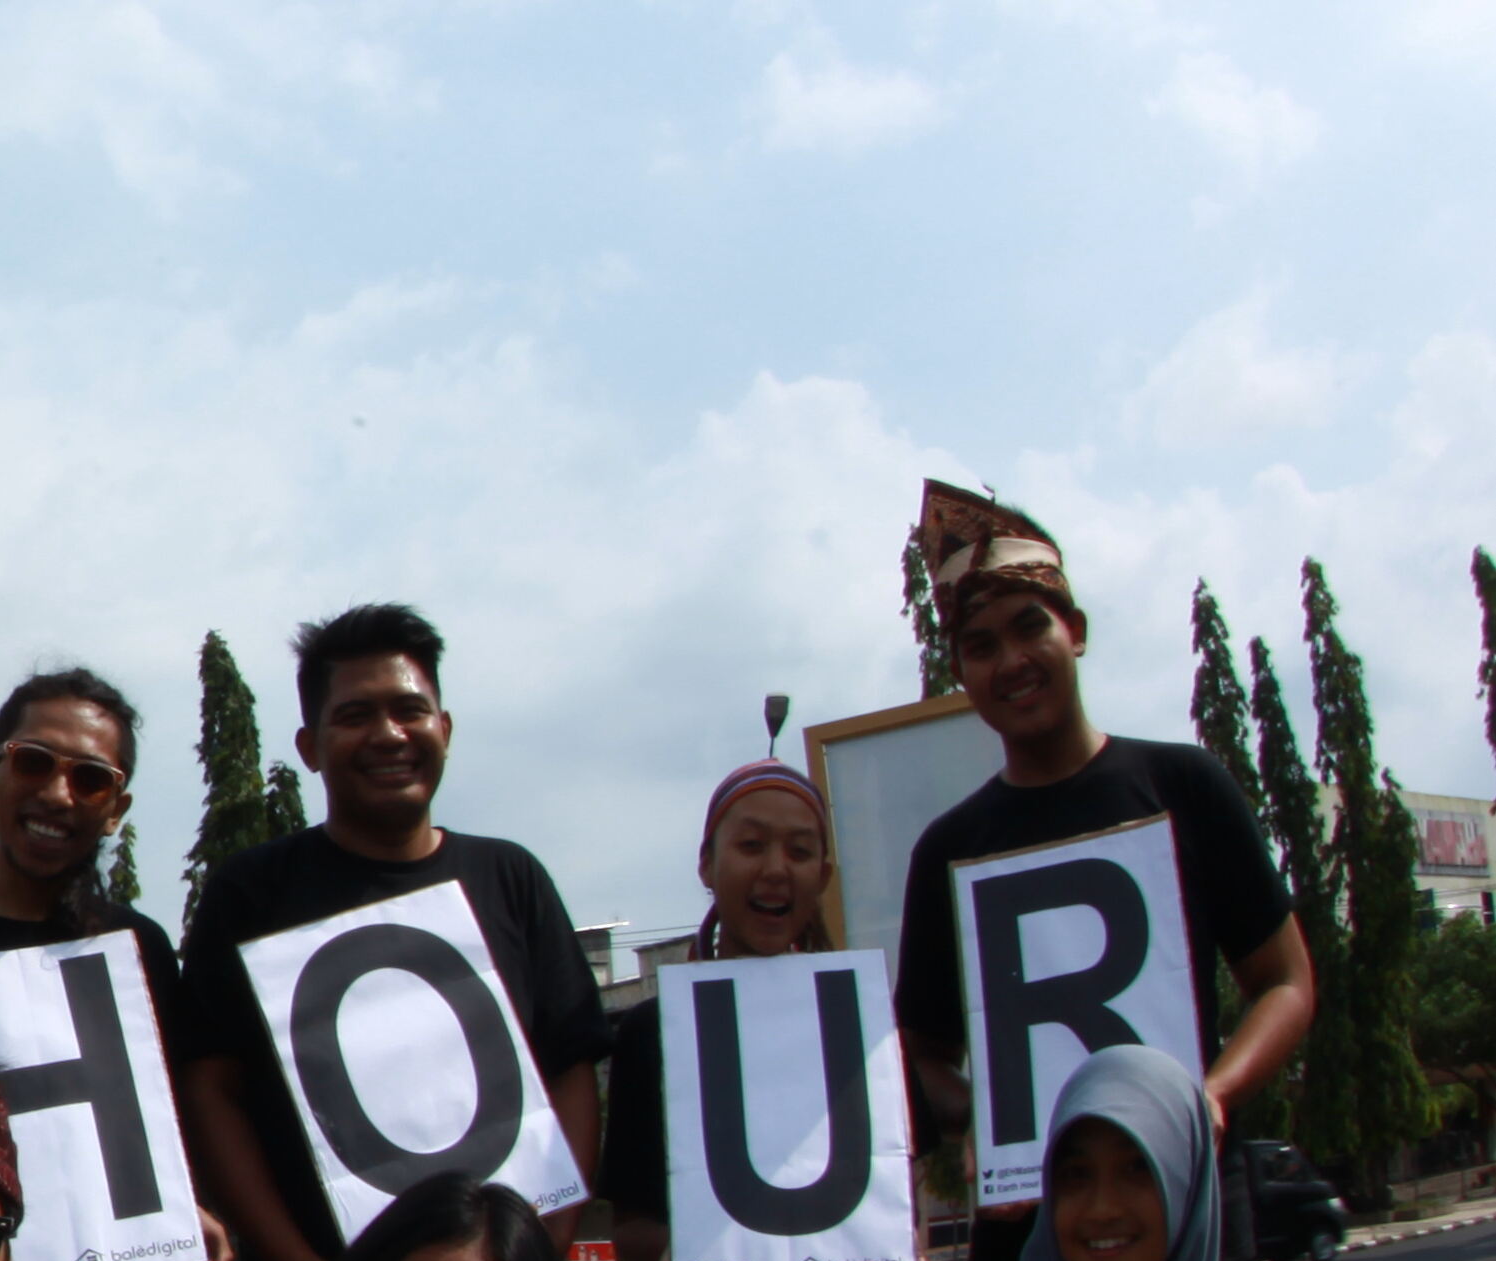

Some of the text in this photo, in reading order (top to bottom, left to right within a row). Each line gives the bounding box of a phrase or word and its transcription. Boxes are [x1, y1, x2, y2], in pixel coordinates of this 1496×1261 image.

[290, 923, 523, 1198] O
[692, 968, 872, 1236] U
[971, 857, 1149, 1146] R
[534, 1181, 580, 1208] digital
